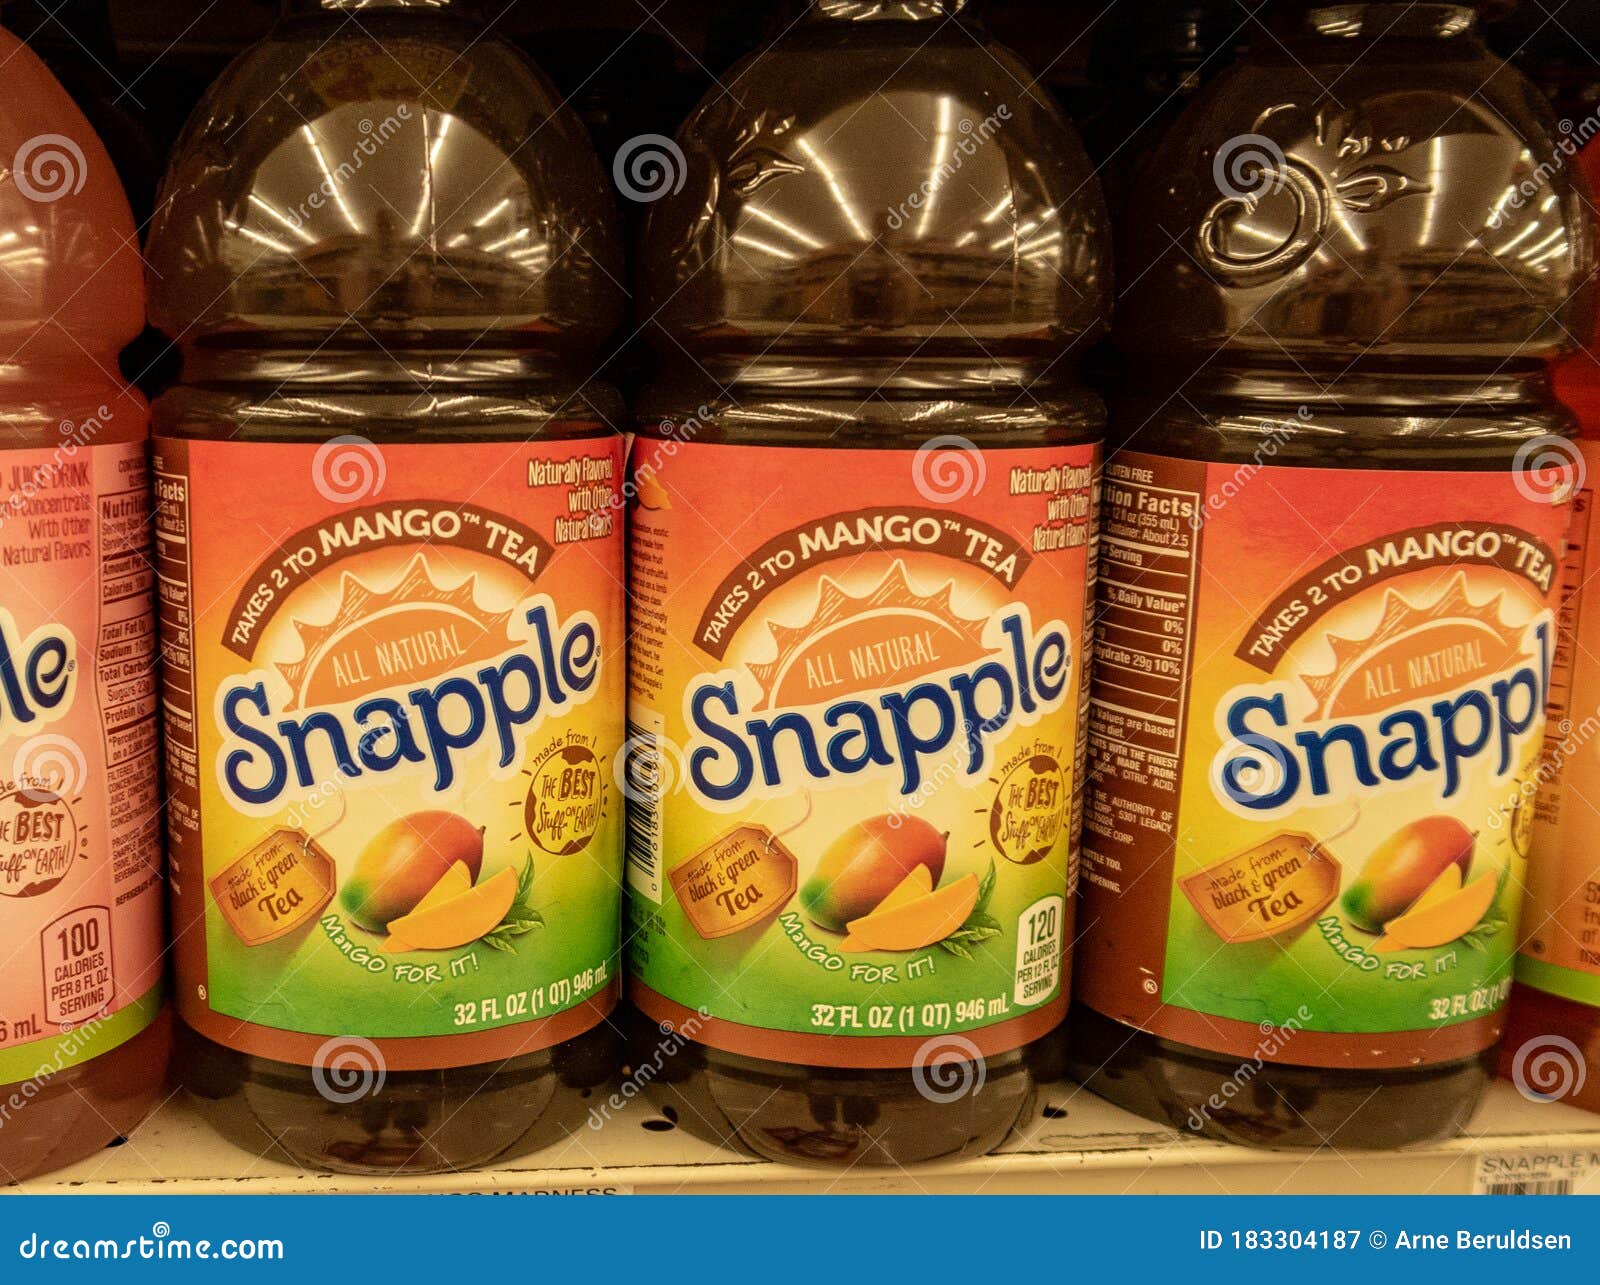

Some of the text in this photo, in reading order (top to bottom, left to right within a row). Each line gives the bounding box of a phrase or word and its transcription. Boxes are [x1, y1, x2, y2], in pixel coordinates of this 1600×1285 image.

[52, 461, 90, 488] DRINK
[528, 456, 581, 487] Naturally
[1010, 466, 1062, 494] Naturally
[1131, 467, 1154, 484] FREE
[22, 494, 91, 517] Concentrate
[568, 485, 592, 512] with
[1047, 494, 1089, 521] with Other
[1137, 490, 1193, 518] Facts
[28, 520, 58, 540] With
[61, 518, 91, 537] Other
[555, 515, 588, 544] Natural
[1138, 512, 1180, 533] (355 mL)
[1142, 527, 1190, 547] About 2.5
[1033, 524, 1066, 552] Natural
[2, 540, 91, 567] Natural Flavors
[1108, 544, 1143, 566] Serving
[102, 581, 133, 598] Calories
[230, 583, 275, 646] TAKES
[274, 568, 290, 591] 2
[283, 545, 318, 575] TO
[484, 520, 540, 575] TEA
[703, 584, 749, 646] TAKES
[746, 569, 765, 591] 2
[759, 549, 796, 577] TO
[964, 527, 1018, 583] TEA
[1118, 590, 1143, 608] Daily
[1249, 598, 1309, 660] TAKES
[1306, 585, 1327, 605] 2
[1322, 564, 1363, 592] TO
[1515, 541, 1553, 591] TEA
[102, 624, 122, 641] Total
[1163, 619, 1184, 635] 0%
[100, 644, 132, 662] Sodium
[331, 623, 467, 688] ALL NATURAL
[805, 629, 941, 689] ALL NATURAL
[1162, 639, 1183, 655] 0%
[99, 666, 121, 683] Total
[1132, 653, 1180, 676] 29g 10%
[1364, 638, 1488, 700] ALL NATURAL
[107, 683, 137, 702] Sugars
[104, 706, 136, 725] Protein
[1097, 708, 1124, 726] Values
[1126, 718, 1143, 731] are
[1143, 720, 1176, 738] based
[1221, 620, 1549, 811] Snappl
[532, 728, 589, 767] made from
[1000, 737, 1055, 775] made from
[1108, 742, 1128, 757] WITH
[1130, 748, 1146, 761] THE
[1147, 753, 1179, 769] FINEST
[1103, 752, 1178, 780] IS MADE FROM:
[1122, 769, 1149, 785] CITRIC
[541, 767, 596, 802] THE BEST
[1008, 783, 1025, 809] THE
[1024, 777, 1059, 811] BEST
[1095, 789, 1174, 822] THE AUTHORITY OF
[13, 810, 65, 845] BEST
[536, 801, 568, 841] Stuff
[1001, 810, 1032, 850] Stuff
[1118, 810, 1173, 833] 5301 LEGACY
[23, 847, 37, 861] ON
[228, 883, 260, 910] black
[266, 850, 299, 889] green
[687, 876, 718, 903] black
[726, 849, 760, 885] green
[1210, 880, 1251, 911] black
[1262, 857, 1302, 891] green
[257, 886, 304, 923] Tea
[715, 883, 764, 917] Tea
[1247, 889, 1304, 923] Tea
[57, 918, 100, 962] 100
[1028, 906, 1057, 946] 120
[54, 951, 105, 983] CALORIES
[394, 964, 442, 983] FOR
[450, 952, 480, 978] IT!
[1023, 940, 1057, 966] CALORIES
[1384, 962, 1427, 980] FOR
[1434, 951, 1457, 974] IT!
[851, 963, 898, 984] FOR
[907, 955, 936, 979] IT!
[1016, 952, 1059, 984] PER 12 FL OZ
[51, 967, 109, 1001] PER 8 FL OZ
[454, 962, 608, 1026] 32 FL OZ (1 QT) 946 mL
[1023, 973, 1054, 1000] SERVING
[59, 987, 105, 1017] SERVING
[811, 992, 1010, 1032] 32 FL OZ (1 QT) 946 mL
[1429, 998, 1450, 1021] 32
[1450, 994, 1468, 1017] FL
[1471, 986, 1488, 1012] OZ
[14, 1013, 42, 1039] mL
[1482, 1153, 1586, 1174] SNAPPLE
